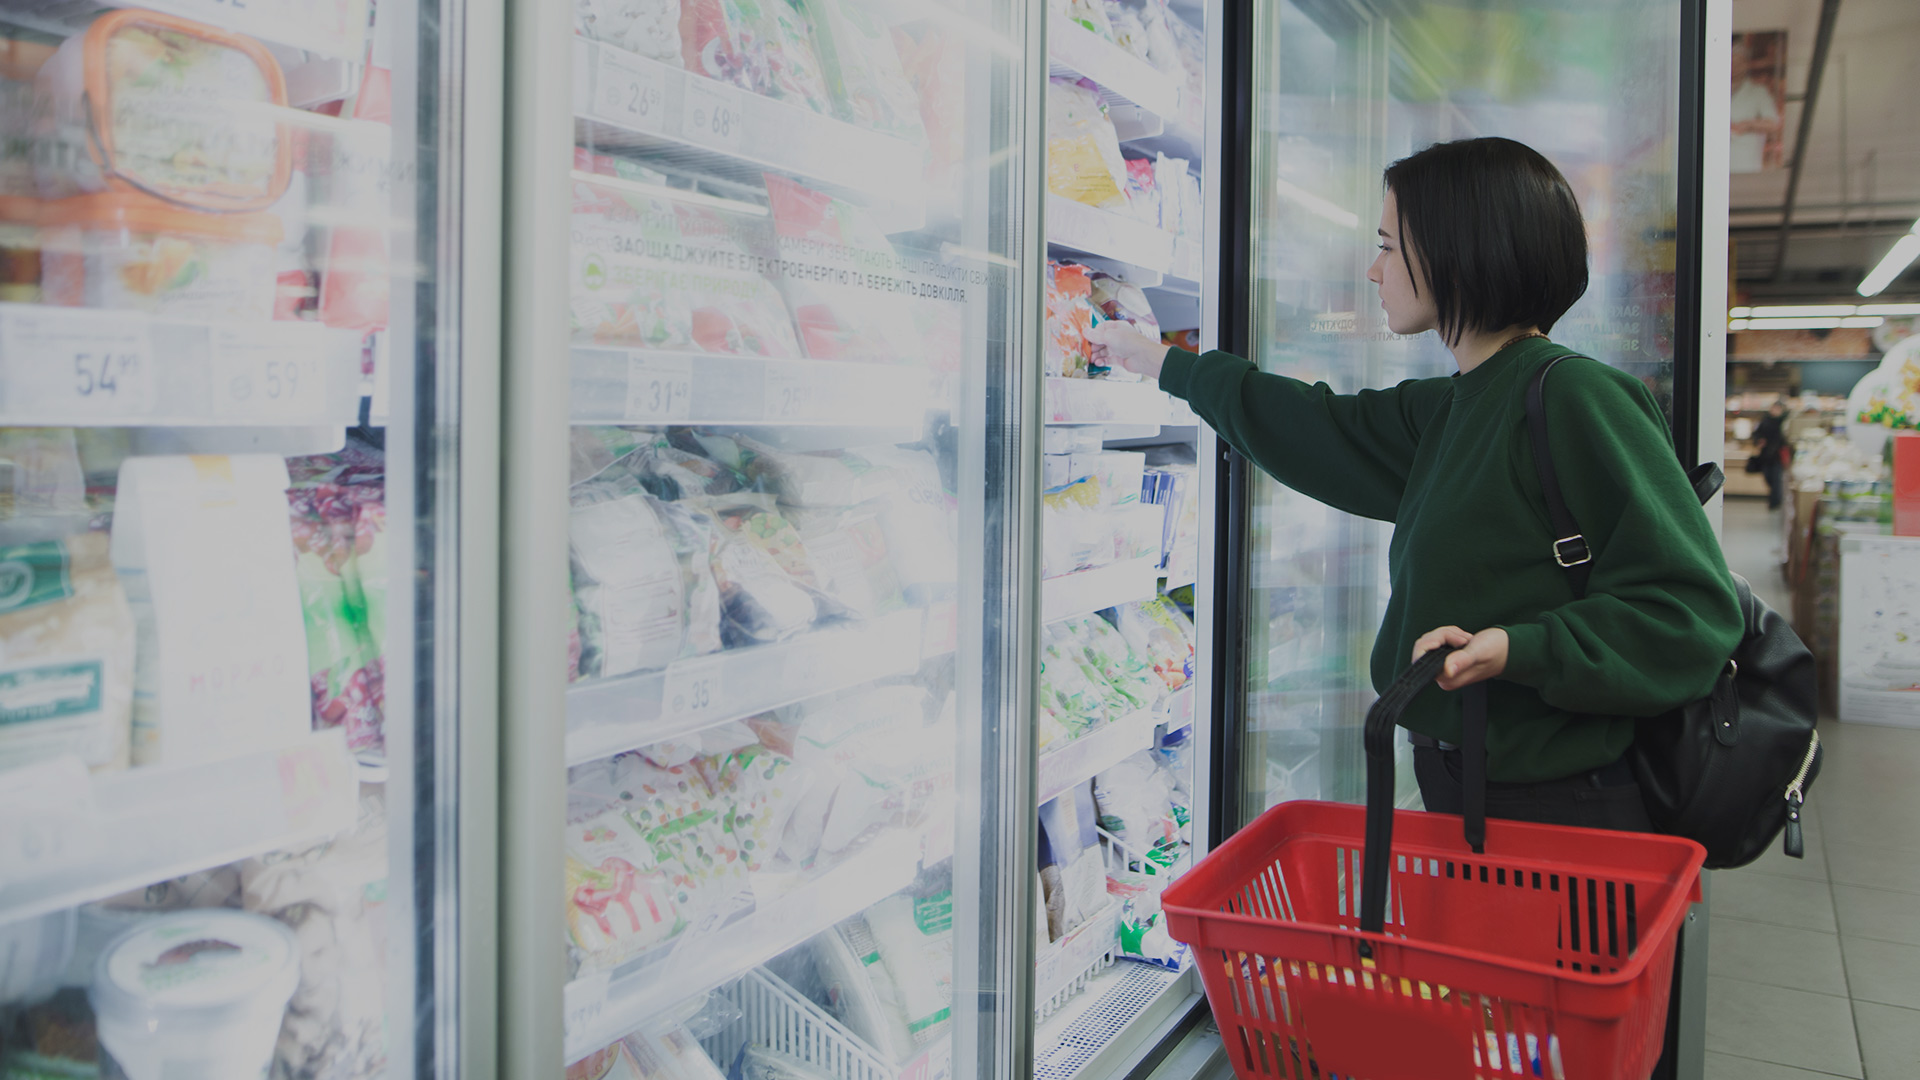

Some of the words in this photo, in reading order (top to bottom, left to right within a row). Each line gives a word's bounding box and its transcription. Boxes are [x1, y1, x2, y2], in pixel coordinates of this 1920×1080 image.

[627, 81, 650, 117] 26
[711, 104, 731, 138] 68
[612, 234, 736, 271] ЗАОЩАДЖУЙТЕ
[737, 252, 849, 287] ЕЛЕКТРОЕНЕРГІЮ
[851, 271, 865, 288] ТА
[866, 273, 918, 296] БЕРЕЖІТЬ
[922, 260, 969, 283] ПРОДУКТИ
[73, 351, 118, 398] 54
[265, 360, 298, 399] 59
[648, 379, 673, 414] 31
[690, 678, 710, 710] 35
